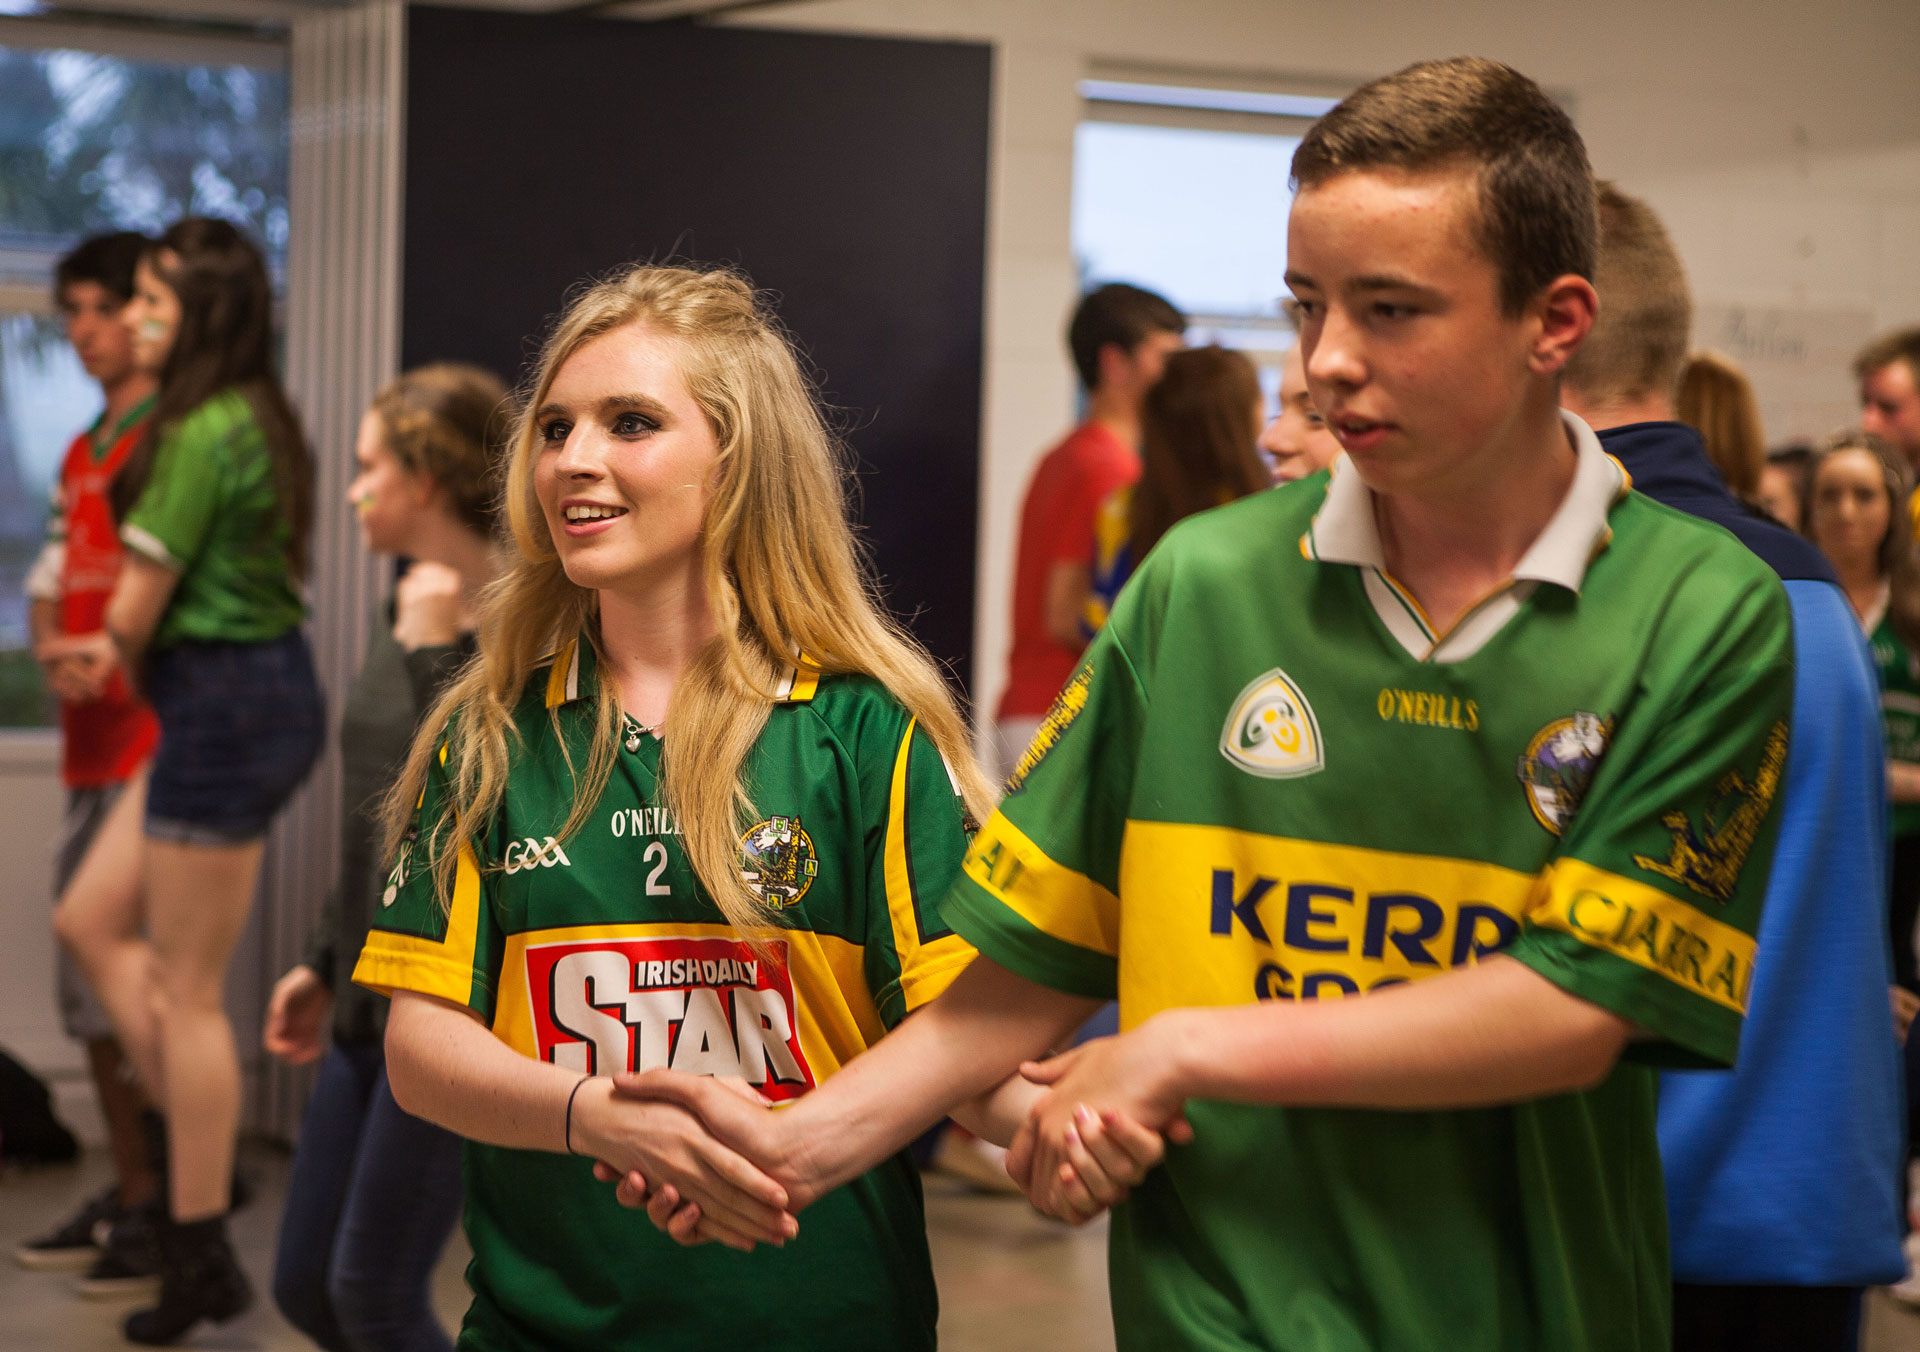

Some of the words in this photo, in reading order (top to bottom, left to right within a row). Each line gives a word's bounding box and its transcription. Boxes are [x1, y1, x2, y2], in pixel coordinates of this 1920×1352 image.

[1376, 688, 1480, 732] O'NEILLS
[611, 807, 687, 838] O'NEILL
[643, 841, 672, 896] 2
[1210, 866, 1521, 967] KERR
[635, 959, 700, 988] IRISH
[701, 957, 759, 988] DAILY
[550, 950, 807, 1086] STAR
